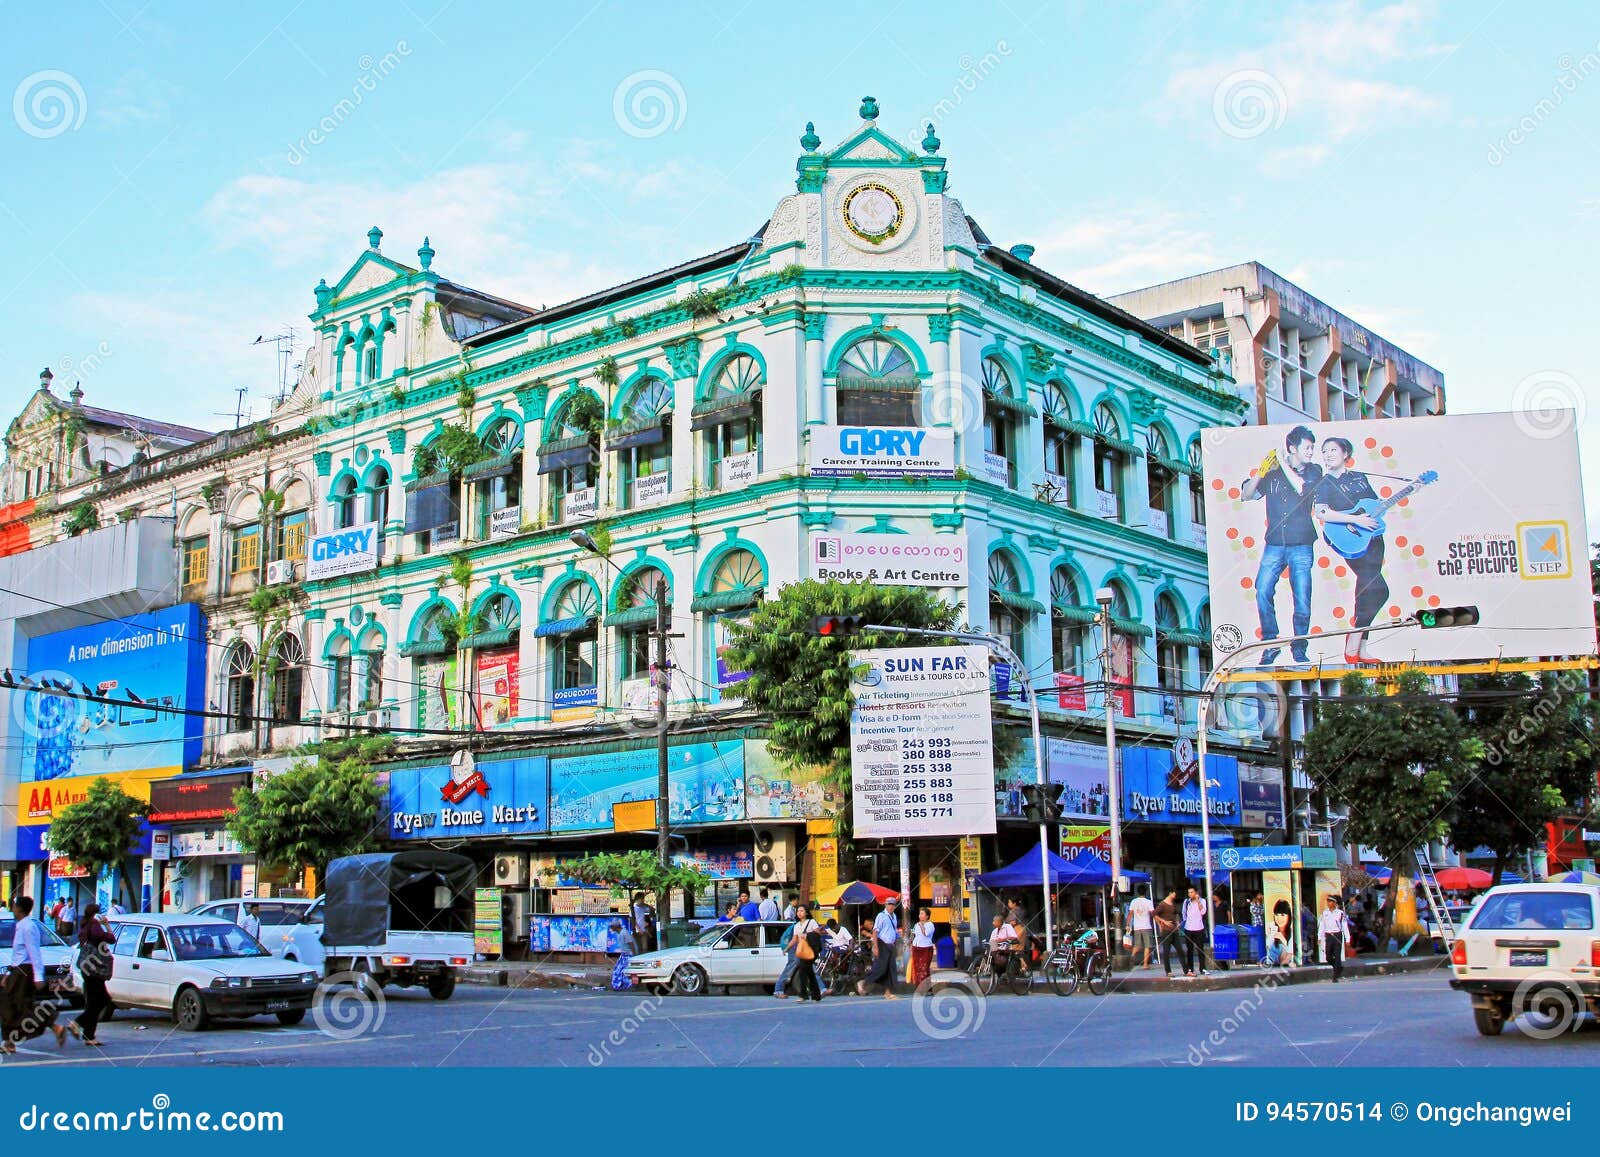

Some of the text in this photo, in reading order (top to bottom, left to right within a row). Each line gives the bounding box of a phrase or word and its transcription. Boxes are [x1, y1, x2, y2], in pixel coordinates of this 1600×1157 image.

[840, 428, 926, 456] GLORY
[860, 458, 902, 467] Training
[574, 492, 588, 502] Civil
[312, 528, 374, 561] GLORY
[1530, 562, 1562, 574] STEP
[818, 568, 960, 581] Books & Art Centre
[68, 645, 76, 663] A
[78, 645, 98, 661] new
[101, 632, 153, 656] dimension
[171, 622, 185, 643] TV
[884, 656, 967, 673] SUN FAR
[886, 674, 919, 682] TRAVELS
[928, 673, 952, 681] TOURS
[859, 692, 871, 700] Air
[872, 691, 910, 701] Ticketing
[859, 703, 885, 711] Hotels
[896, 702, 926, 710] Resorts
[860, 715, 876, 723] Visa
[892, 713, 921, 721] D-form
[860, 726, 896, 735] Incentive
[898, 725, 915, 733] Tour
[873, 743, 898, 752] Street
[902, 739, 924, 748] 243
[928, 738, 951, 748] 993
[902, 750, 925, 760] 380
[929, 749, 952, 758] 888
[903, 763, 952, 773] 255 338
[903, 778, 953, 789] 255 883
[28, 787, 52, 811] AA
[904, 793, 953, 804] 206 188
[1132, 792, 1166, 815] Kyaw
[1170, 793, 1201, 813] Home
[393, 802, 537, 833] Kyaw Home Mart
[873, 813, 900, 821] Bahan
[904, 807, 953, 818] 555 771
